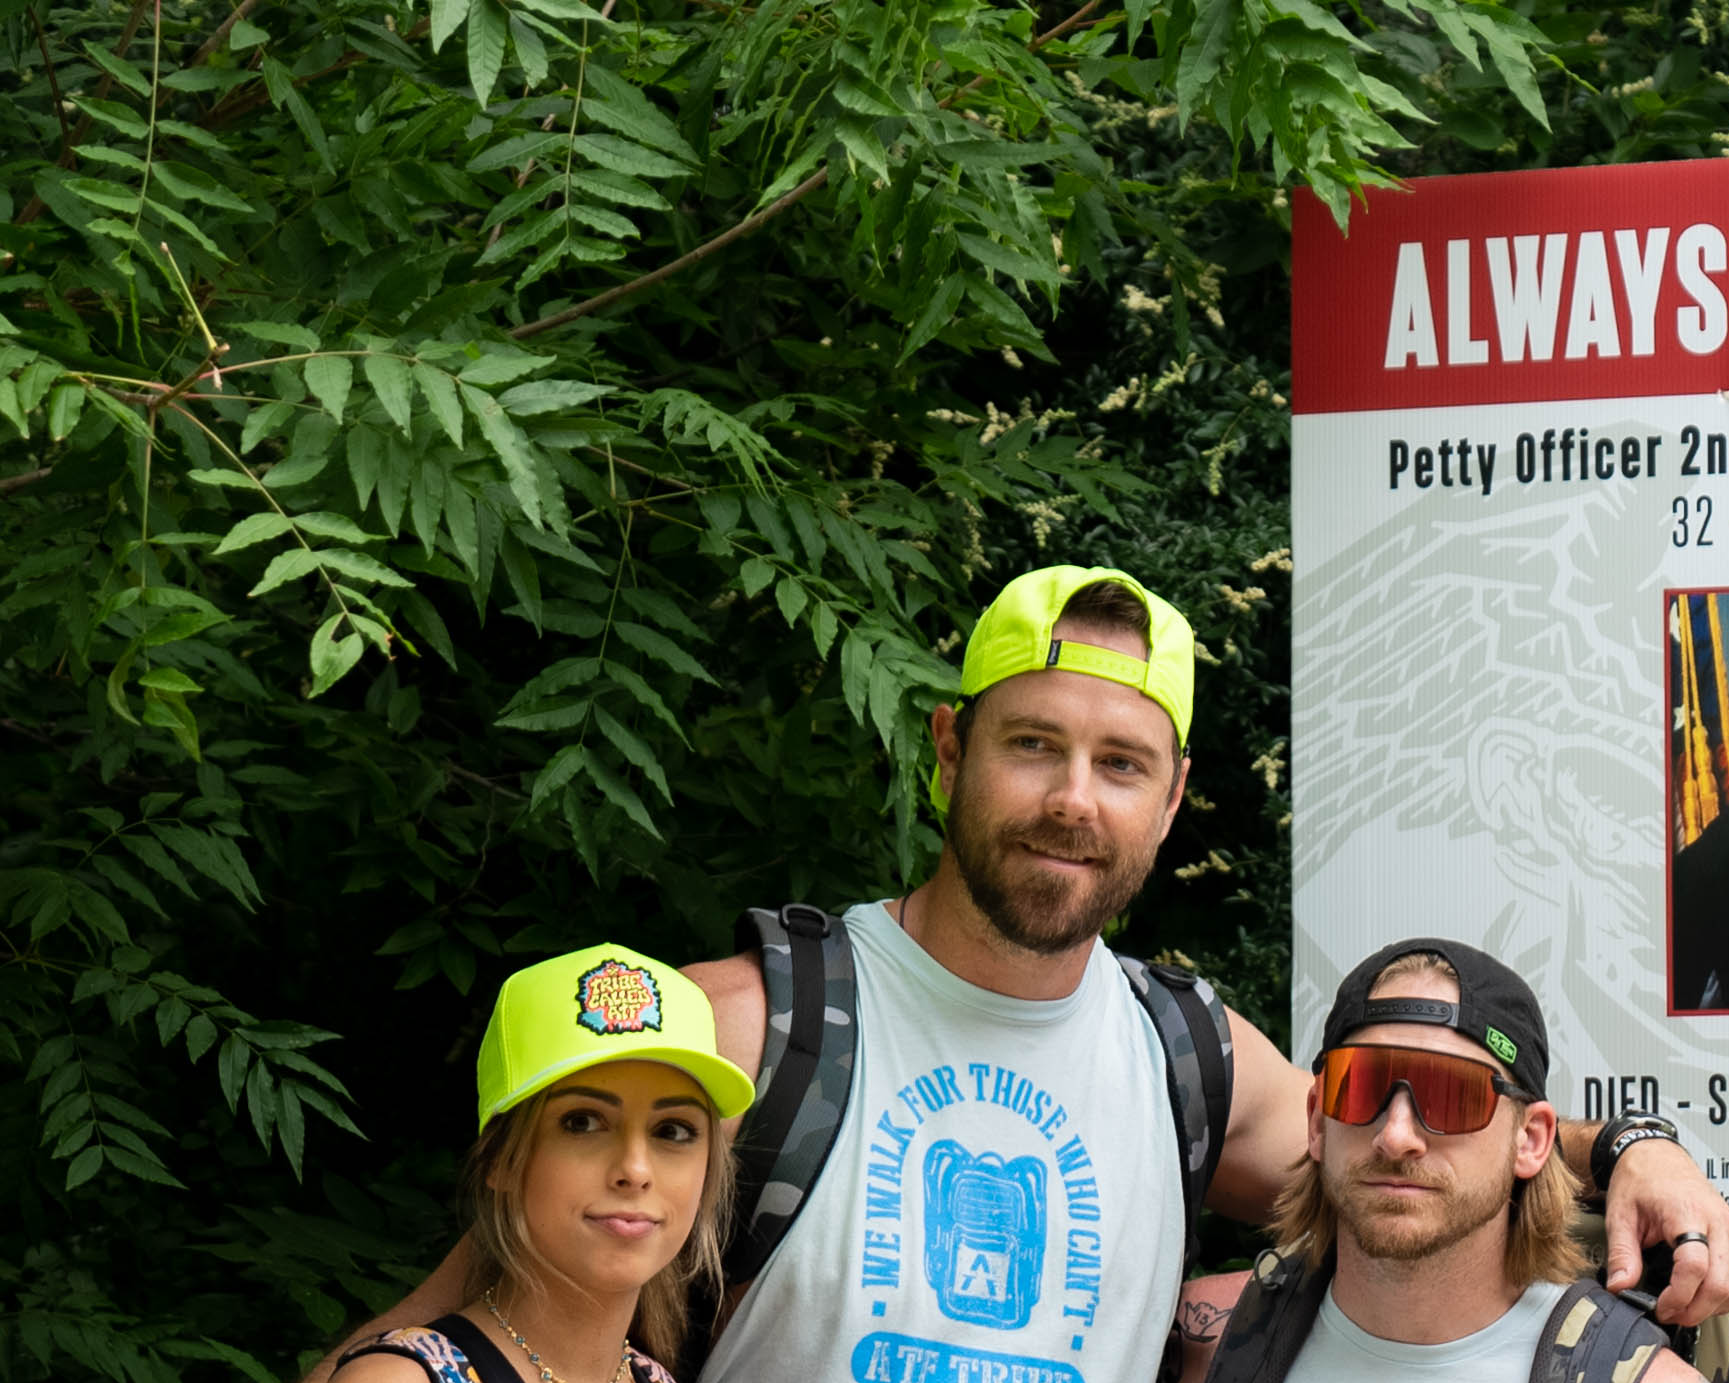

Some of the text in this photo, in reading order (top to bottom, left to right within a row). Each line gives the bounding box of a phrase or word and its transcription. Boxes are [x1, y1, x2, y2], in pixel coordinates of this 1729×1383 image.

[1385, 224, 1727, 367] ALWAYS
[1390, 439, 1495, 495] Petty
[1517, 429, 1661, 483] Officer
[1673, 496, 1712, 547] 32
[588, 988, 652, 1009] CALLED
[589, 973, 643, 995] TRIBE
[1585, 1076, 1660, 1119] DIED
[1707, 1159, 1716, 1179] IL
[861, 1062, 1102, 1328] WE WALK FOR THOSE WHO CAN'T
